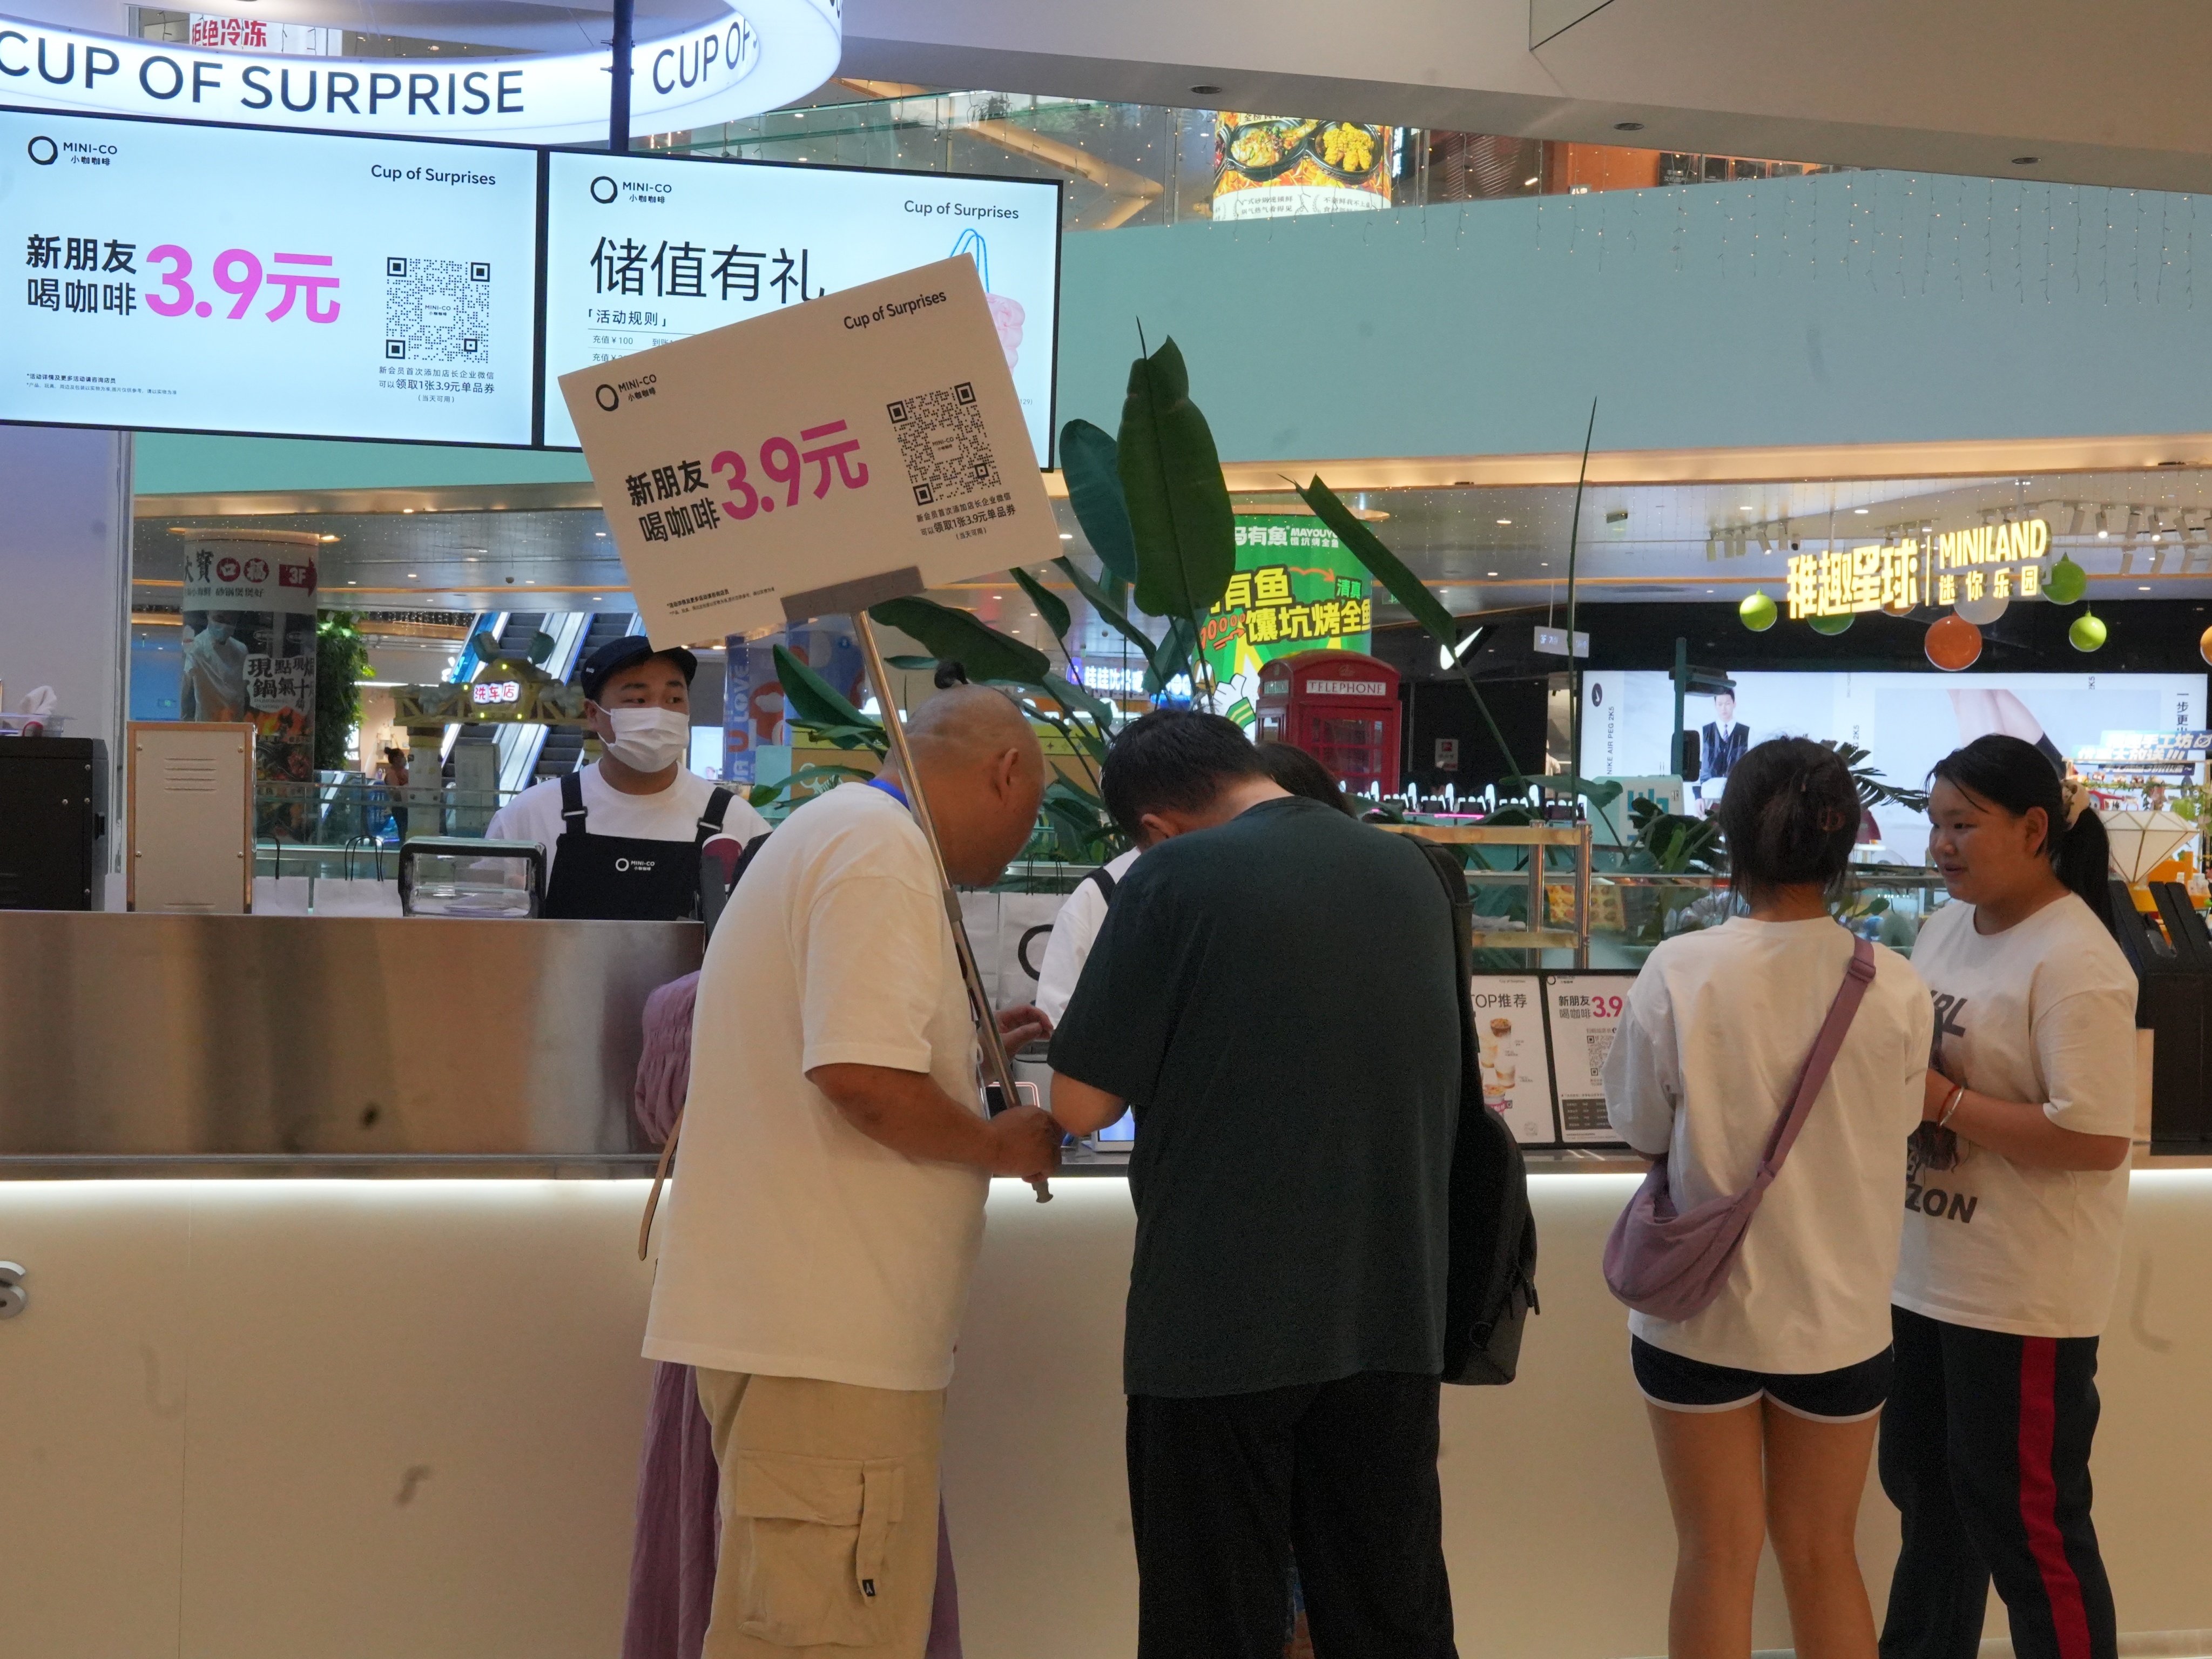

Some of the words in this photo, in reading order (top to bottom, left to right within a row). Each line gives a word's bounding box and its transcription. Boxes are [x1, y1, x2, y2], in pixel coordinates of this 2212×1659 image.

[0, 30, 120, 89] CUP
[139, 56, 222, 103] OF
[240, 66, 524, 115] SURPRISE
[653, 34, 719, 95] CUP
[63, 141, 118, 155] MINI-CO
[371, 164, 402, 182] Cup
[406, 166, 422, 180] of
[425, 168, 496, 186] Surprises
[623, 181, 672, 193] MINI-CO
[904, 200, 932, 216] Cup
[936, 201, 951, 216] of
[954, 203, 1019, 220] Surprises
[26, 233, 137, 275] 新朋友
[145, 244, 341, 324] 3.9元
[590, 235, 825, 305] 储值有礼
[26, 278, 137, 316] 喝咖啡
[844, 315, 869, 331] Cup
[872, 305, 884, 323] of
[886, 290, 947, 322] Surprises
[379, 366, 495, 380] 新会员首次添加店长企业微信
[379, 378, 495, 394] 可以领取1张3.9元单品券
[618, 374, 657, 393] MINI-CO
[625, 459, 709, 508] 新朋友
[711, 419, 869, 521] 3.9元
[638, 497, 721, 543] 喝咖啡
[1939, 519, 2047, 570] MINILAND
[1210, 567, 1293, 614] 有鱼
[1337, 578, 1362, 600] 清真
[1939, 565, 2039, 605] 迷你乐园
[475, 684, 515, 700] 洗车店
[1310, 682, 1382, 694] TELEPHONE
[1559, 995, 1591, 1007] 新朋友
[1559, 1008, 1591, 1019] 喝咖啡
[1591, 996, 1623, 1018] 3.9
